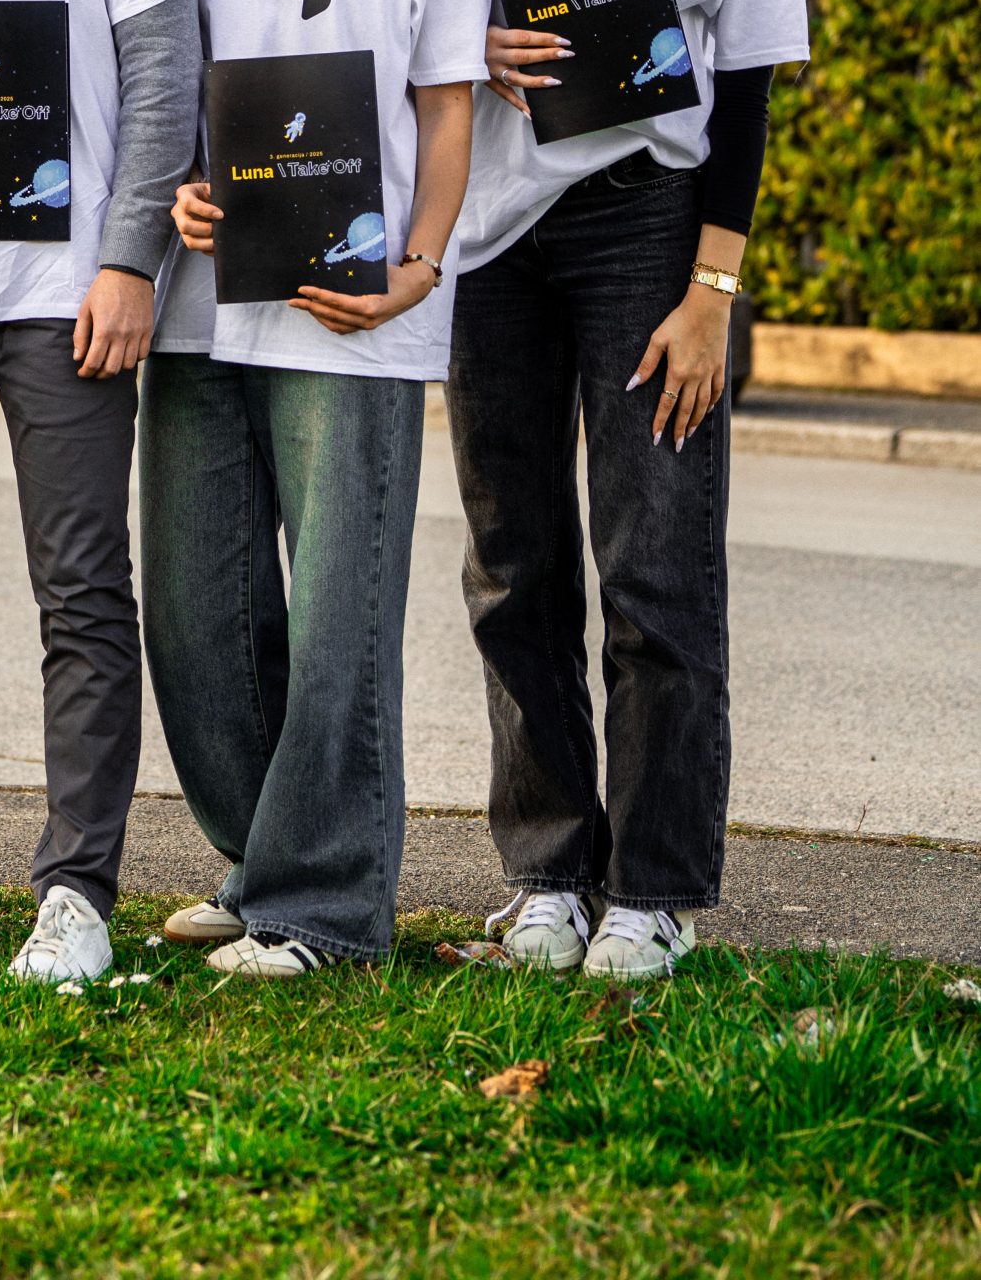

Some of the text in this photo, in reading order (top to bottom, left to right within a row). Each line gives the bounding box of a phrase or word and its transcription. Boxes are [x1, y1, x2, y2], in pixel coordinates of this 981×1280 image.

[526, 2, 569, 23] Luna
[21, 105, 50, 120] Off
[231, 166, 274, 181] Luna
[332, 158, 362, 174] Off
